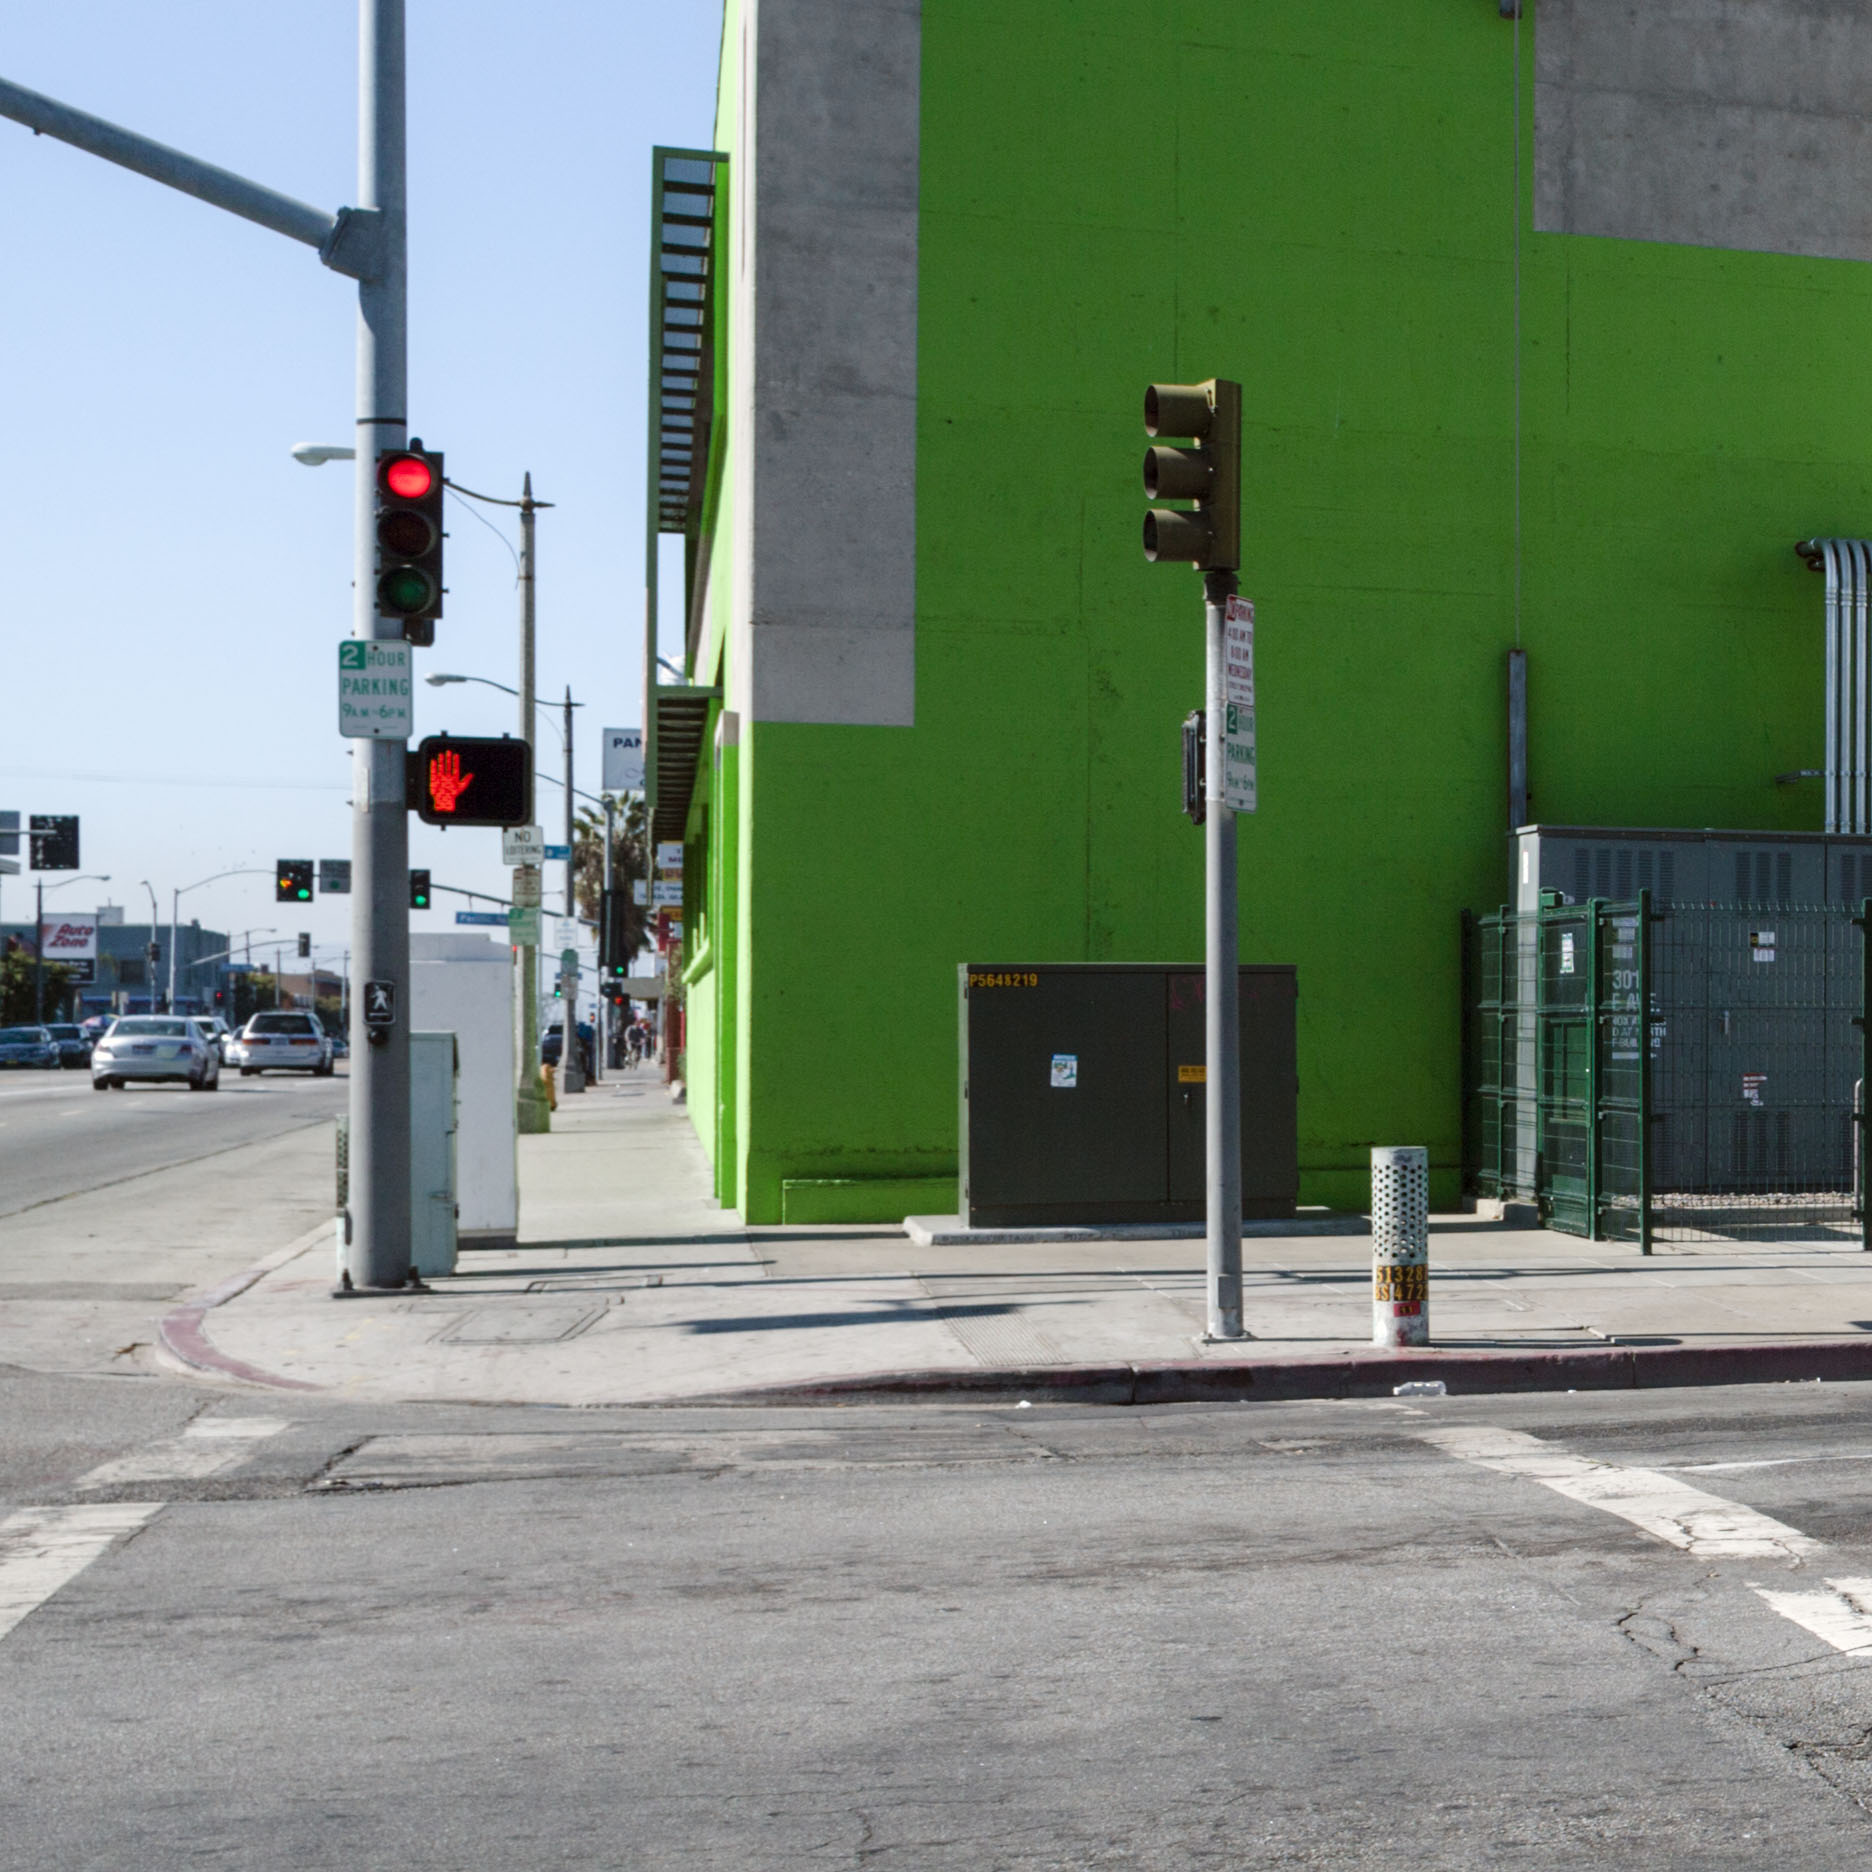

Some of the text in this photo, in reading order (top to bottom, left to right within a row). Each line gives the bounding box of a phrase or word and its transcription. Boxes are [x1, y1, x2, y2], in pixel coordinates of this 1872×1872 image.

[342, 644, 405, 667] 2 HOUR
[342, 678, 409, 696] PARKING
[1228, 706, 1236, 729] 2
[514, 831, 531, 842] NO
[57, 923, 94, 936] Auto
[49, 935, 89, 947] Zone
[969, 973, 1038, 987] P5648219
